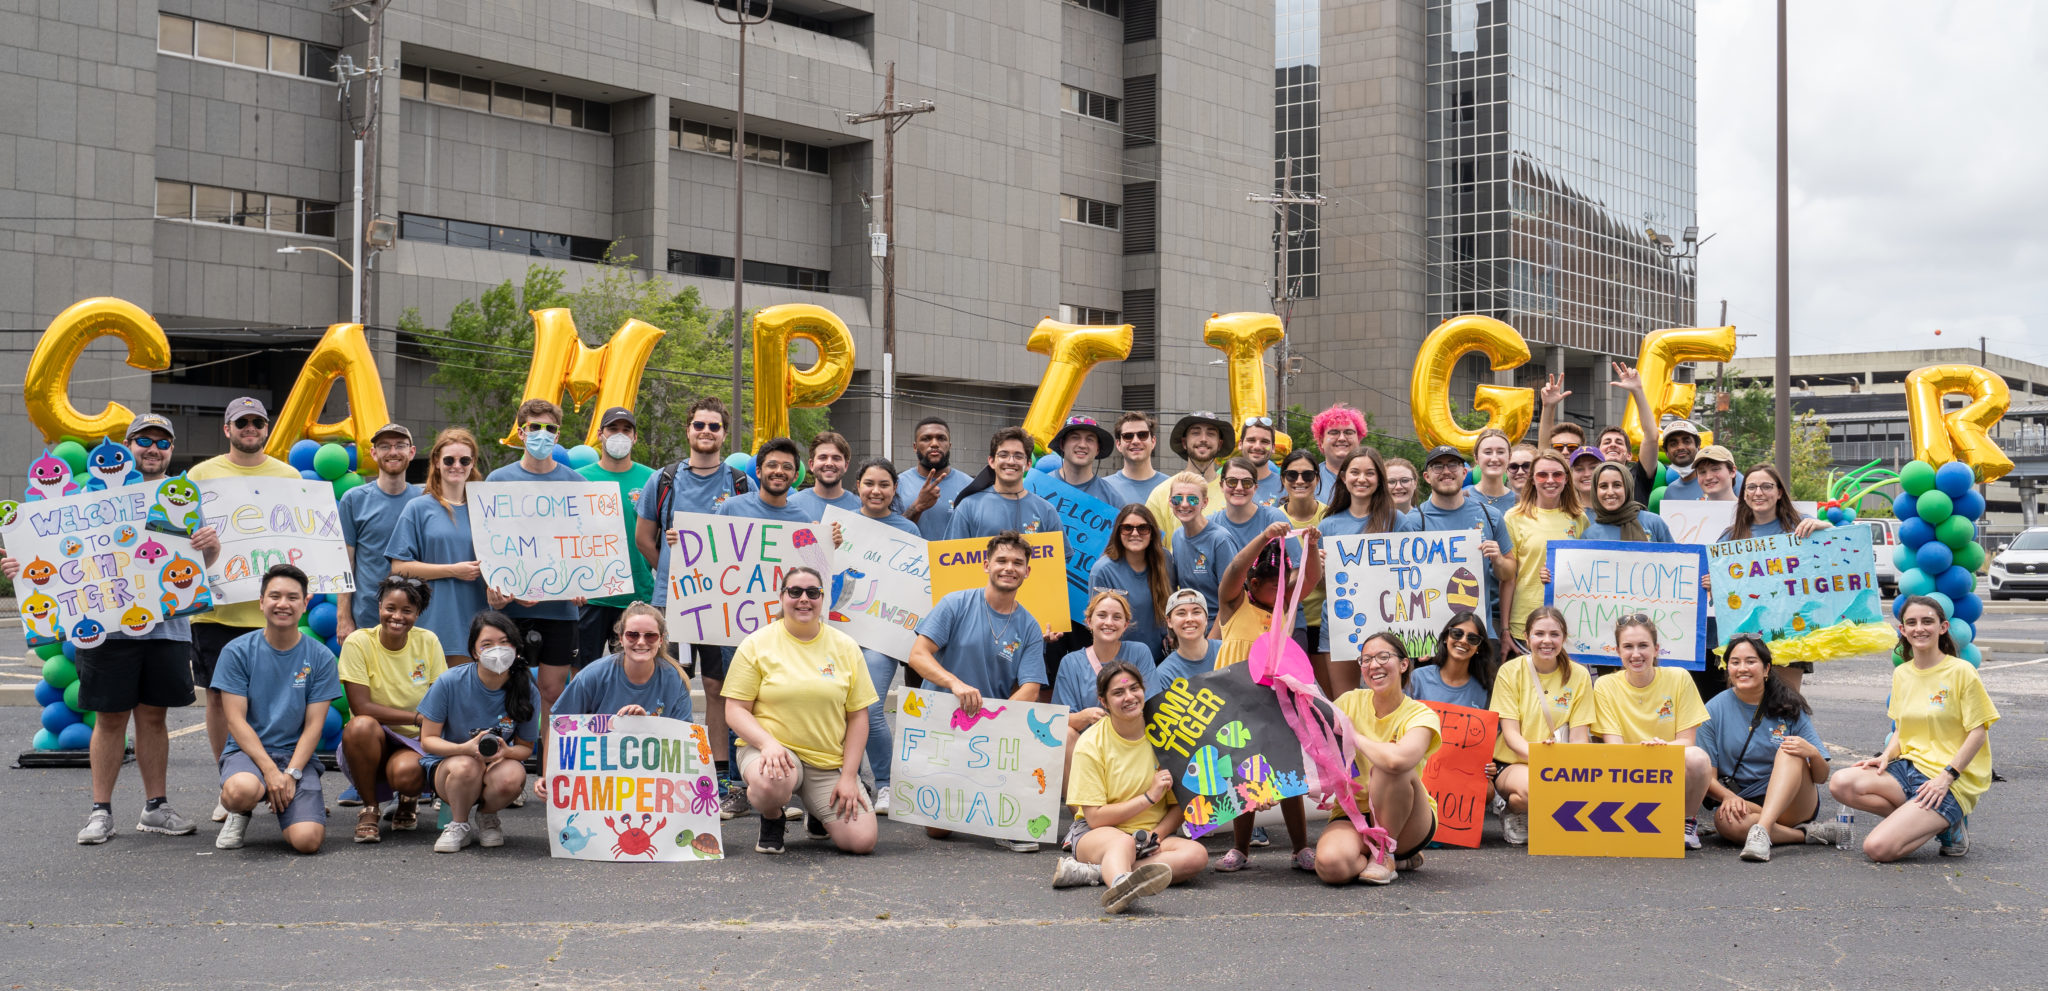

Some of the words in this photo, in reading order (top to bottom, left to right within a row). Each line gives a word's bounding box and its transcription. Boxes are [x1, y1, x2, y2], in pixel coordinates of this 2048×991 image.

[24, 296, 857, 474] CAMP
[30, 493, 146, 537] WELCOME
[478, 493, 580, 518] WELCOME
[1033, 482, 1113, 532] ELCOM
[85, 534, 111, 552] TO
[553, 534, 619, 559] TIGER
[678, 522, 783, 567] DIVE
[938, 549, 988, 567] CAM
[1336, 535, 1467, 566] WELCOME
[1709, 537, 1777, 558] WELCOME
[59, 551, 130, 585] CAMP
[671, 567, 713, 600] into
[1390, 567, 1422, 590] TO
[1567, 559, 1696, 601] WELCOME
[1728, 555, 1800, 580] CAMP
[1784, 571, 1872, 597] TIGER!
[57, 574, 146, 617] TIGER!
[848, 579, 923, 631] JAWSO
[1380, 588, 1441, 623] CAMP
[680, 600, 780, 641] TIGE
[1561, 599, 1684, 641] CAMPRS
[1145, 677, 1195, 749] CAMP
[1164, 687, 1226, 759] TIGER
[558, 735, 700, 774] WELCOME
[901, 727, 1020, 771] FISH
[552, 774, 691, 813] CAMPERS
[1540, 767, 1603, 783] CAMP
[1612, 768, 1674, 784] TIGER
[894, 781, 1021, 827] SQUAD
